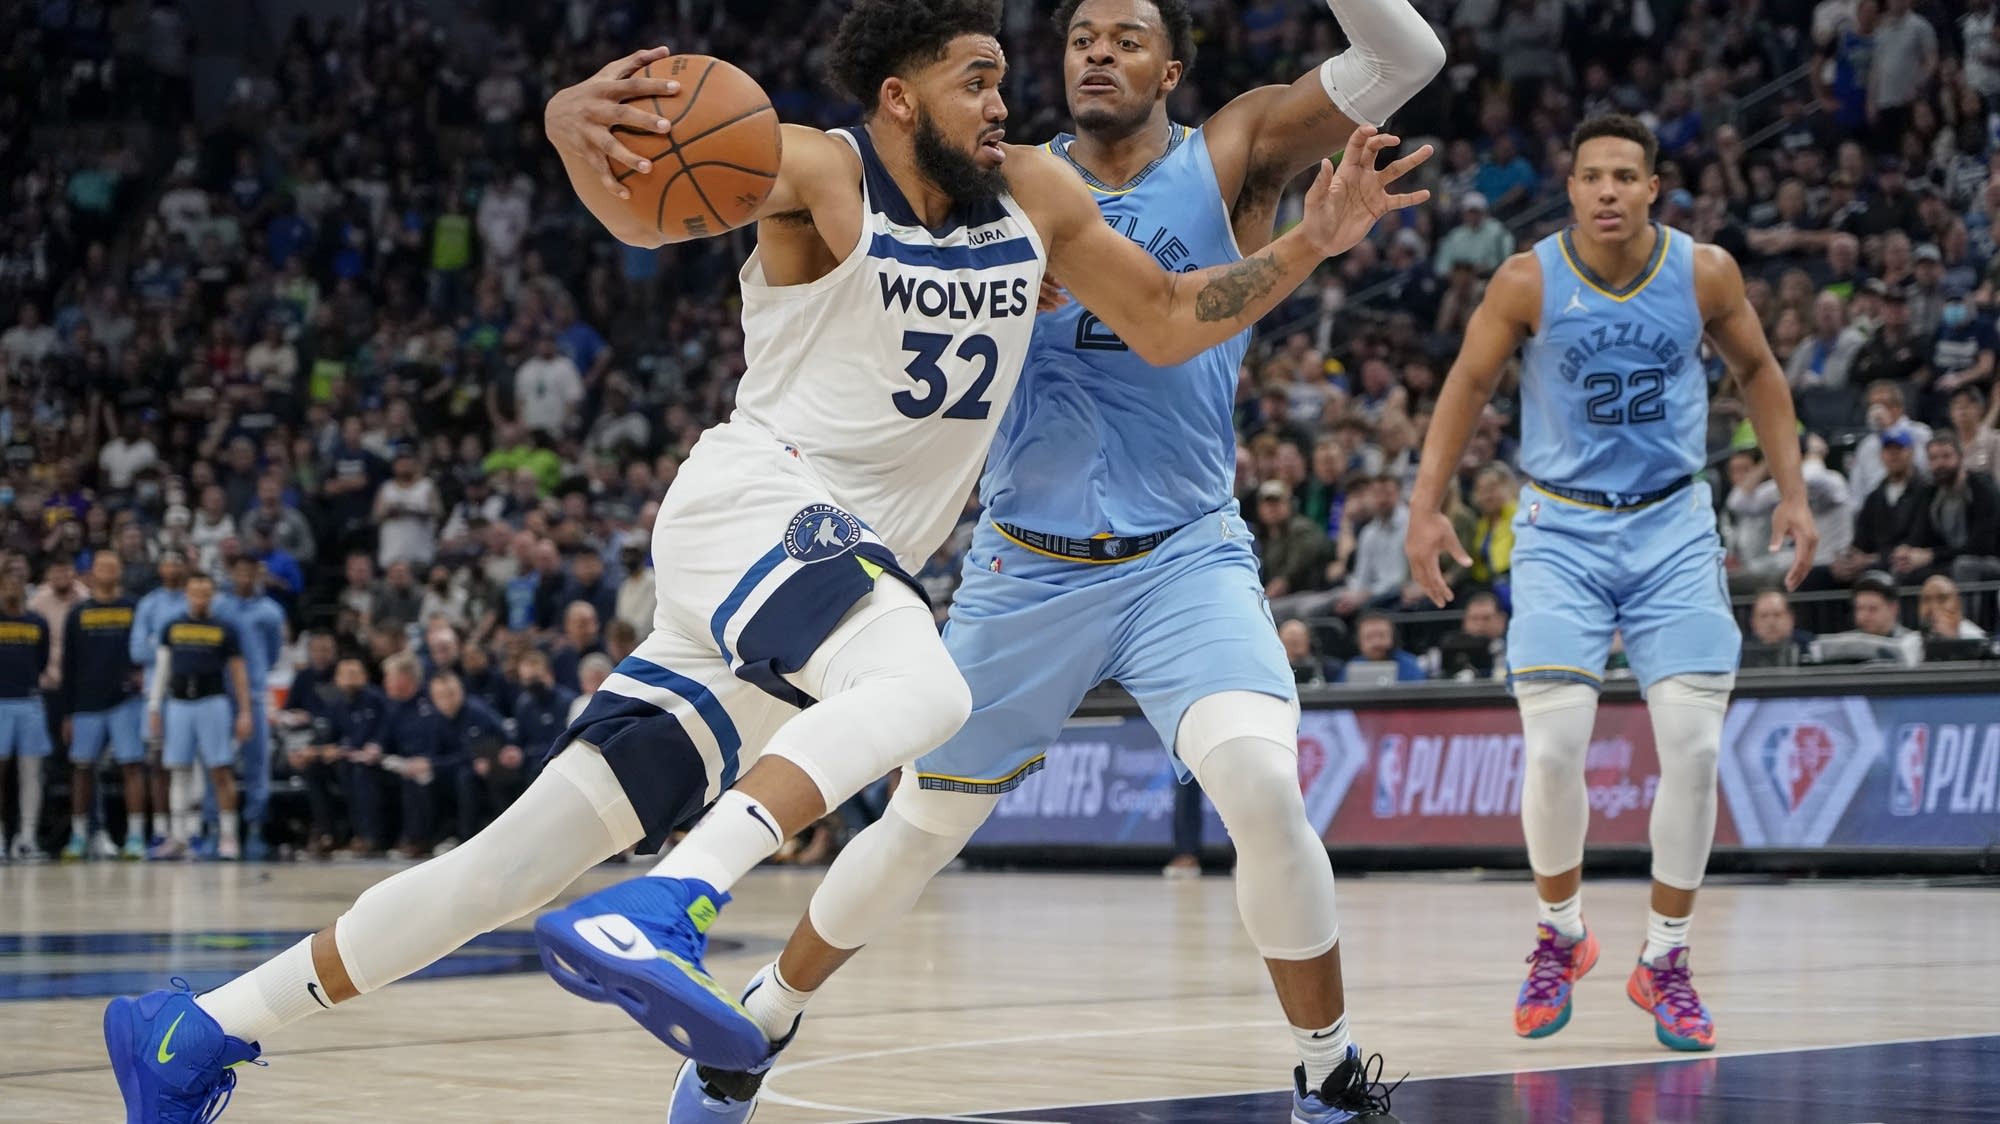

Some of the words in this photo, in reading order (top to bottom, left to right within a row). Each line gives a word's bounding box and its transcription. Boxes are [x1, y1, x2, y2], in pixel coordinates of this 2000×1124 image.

[878, 272, 1028, 320] WOLVES
[891, 330, 999, 420] 32
[1559, 320, 1685, 383] GRIZZLIES
[1584, 367, 1666, 425] 22
[1924, 724, 2000, 814] PLA
